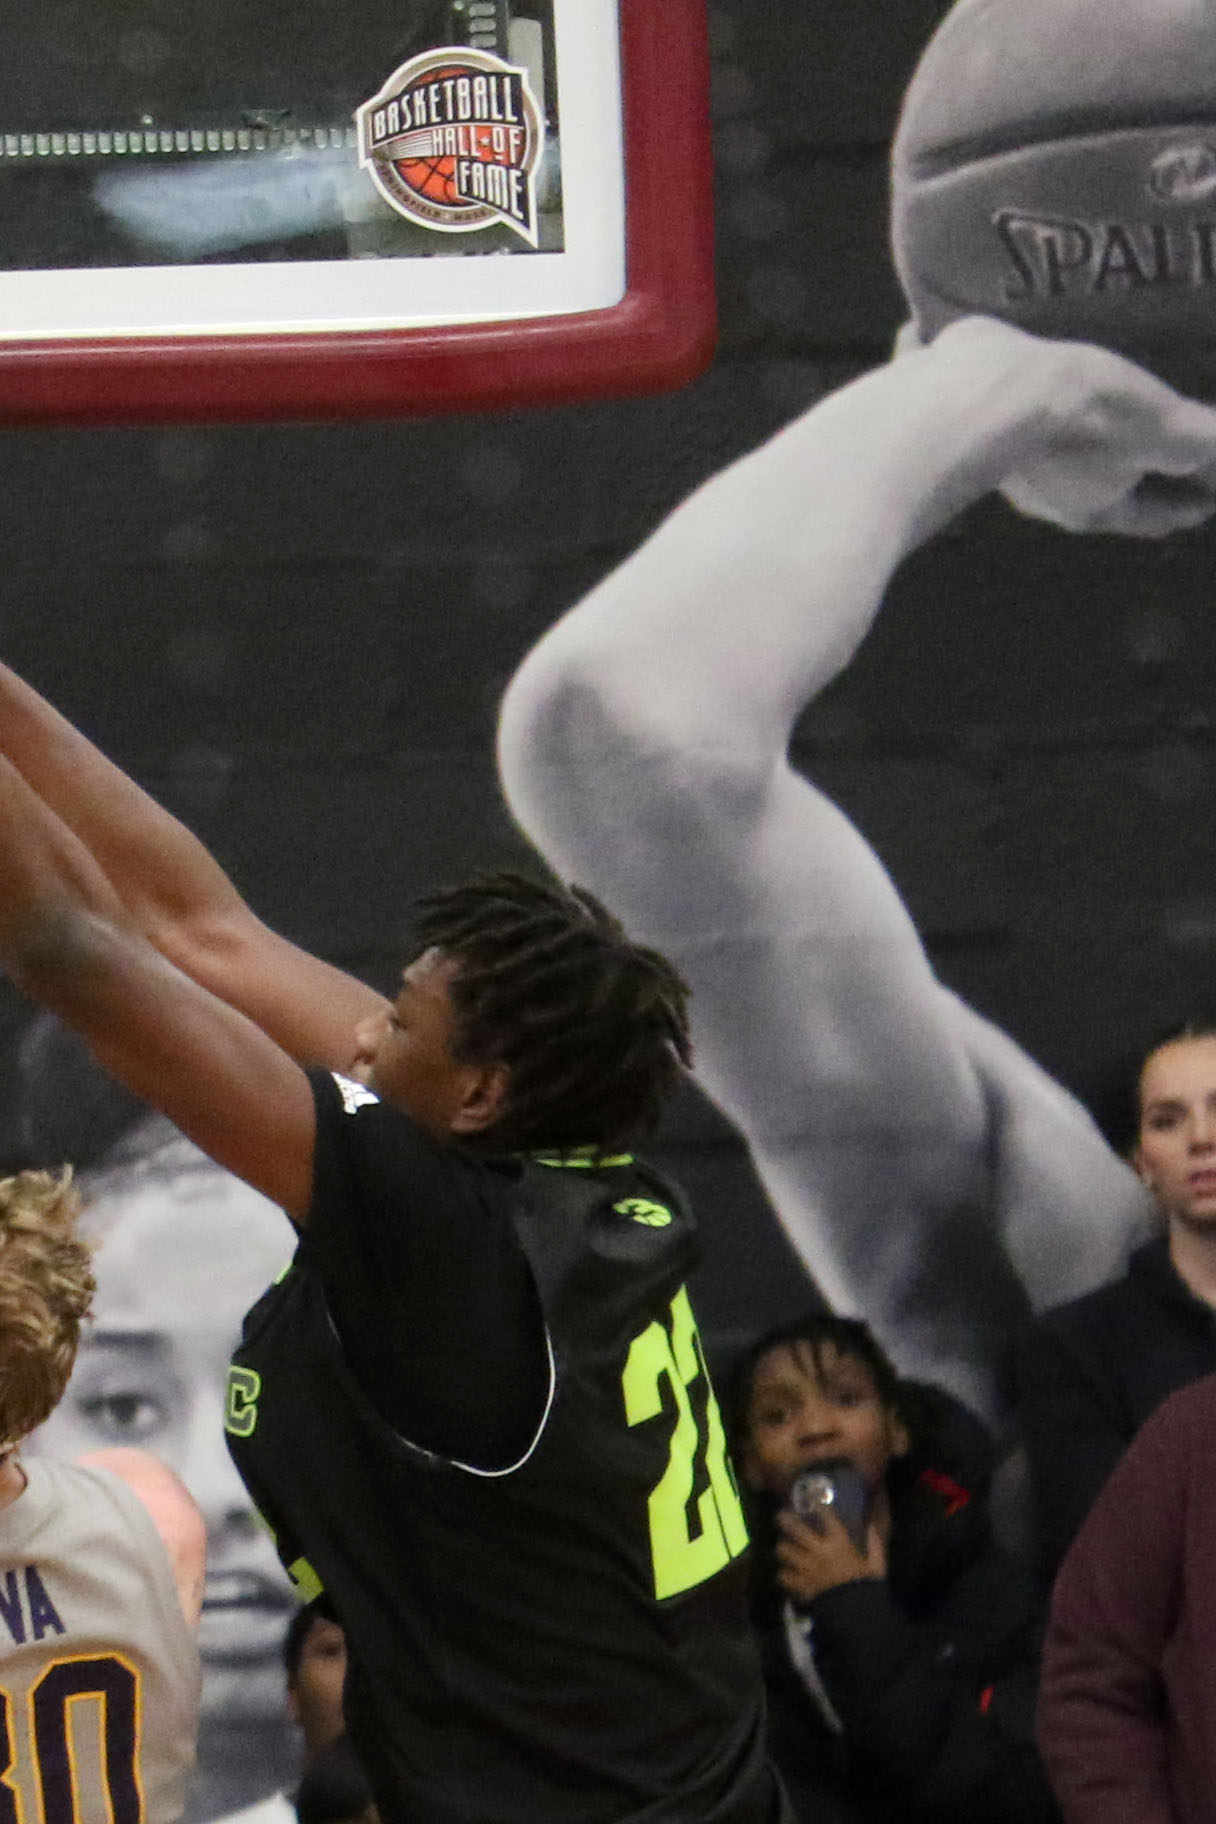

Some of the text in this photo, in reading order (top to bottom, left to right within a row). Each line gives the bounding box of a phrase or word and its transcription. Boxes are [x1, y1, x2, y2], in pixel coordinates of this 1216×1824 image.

[374, 75, 519, 140] BASKETBALL
[432, 125, 523, 165] HALL OF
[458, 160, 524, 221] FAME
[991, 208, 1216, 300] SPAL
